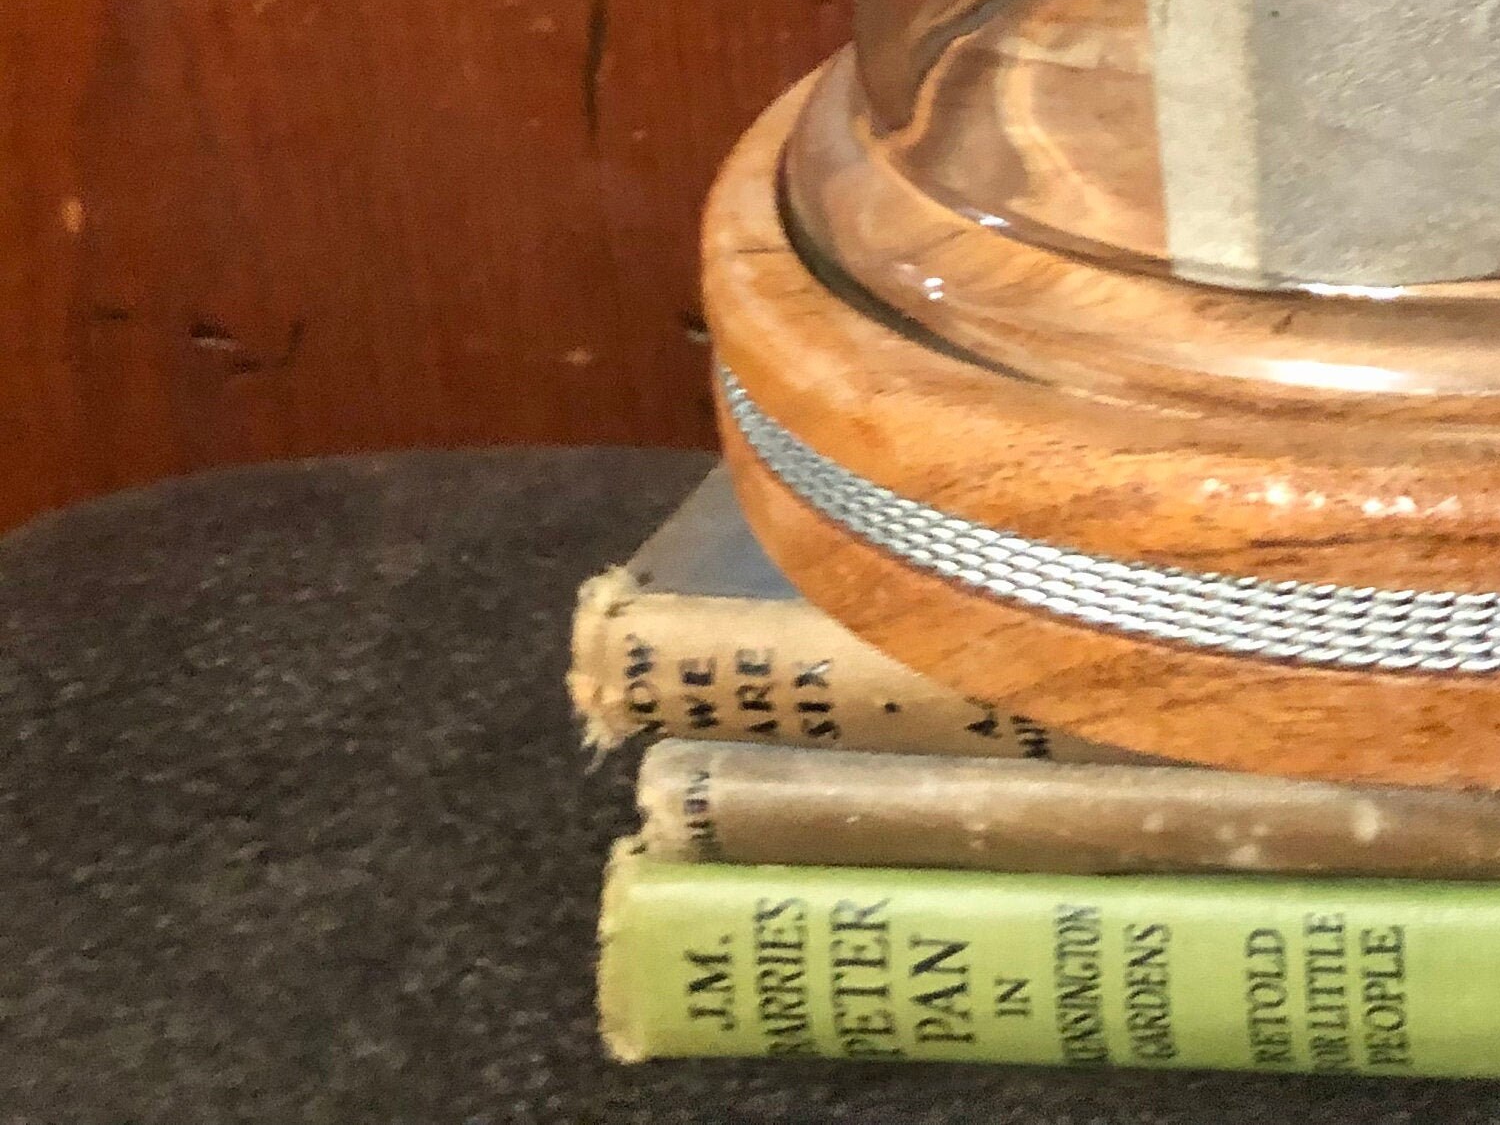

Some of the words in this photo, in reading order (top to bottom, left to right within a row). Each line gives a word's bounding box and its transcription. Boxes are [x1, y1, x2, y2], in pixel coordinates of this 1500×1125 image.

[681, 656, 717, 730] WE
[735, 647, 779, 733] ARE
[793, 659, 838, 738] SIX
[683, 933, 734, 1031] J.M.
[829, 897, 906, 1058] PETER
[907, 934, 975, 1045] PAN
[993, 977, 1031, 1018] IN
[1124, 923, 1178, 1060] GARDENS
[1246, 928, 1293, 1065] RETOLD
[1304, 911, 1348, 1030] LITTLE
[1360, 924, 1410, 1066] PEOPLE
